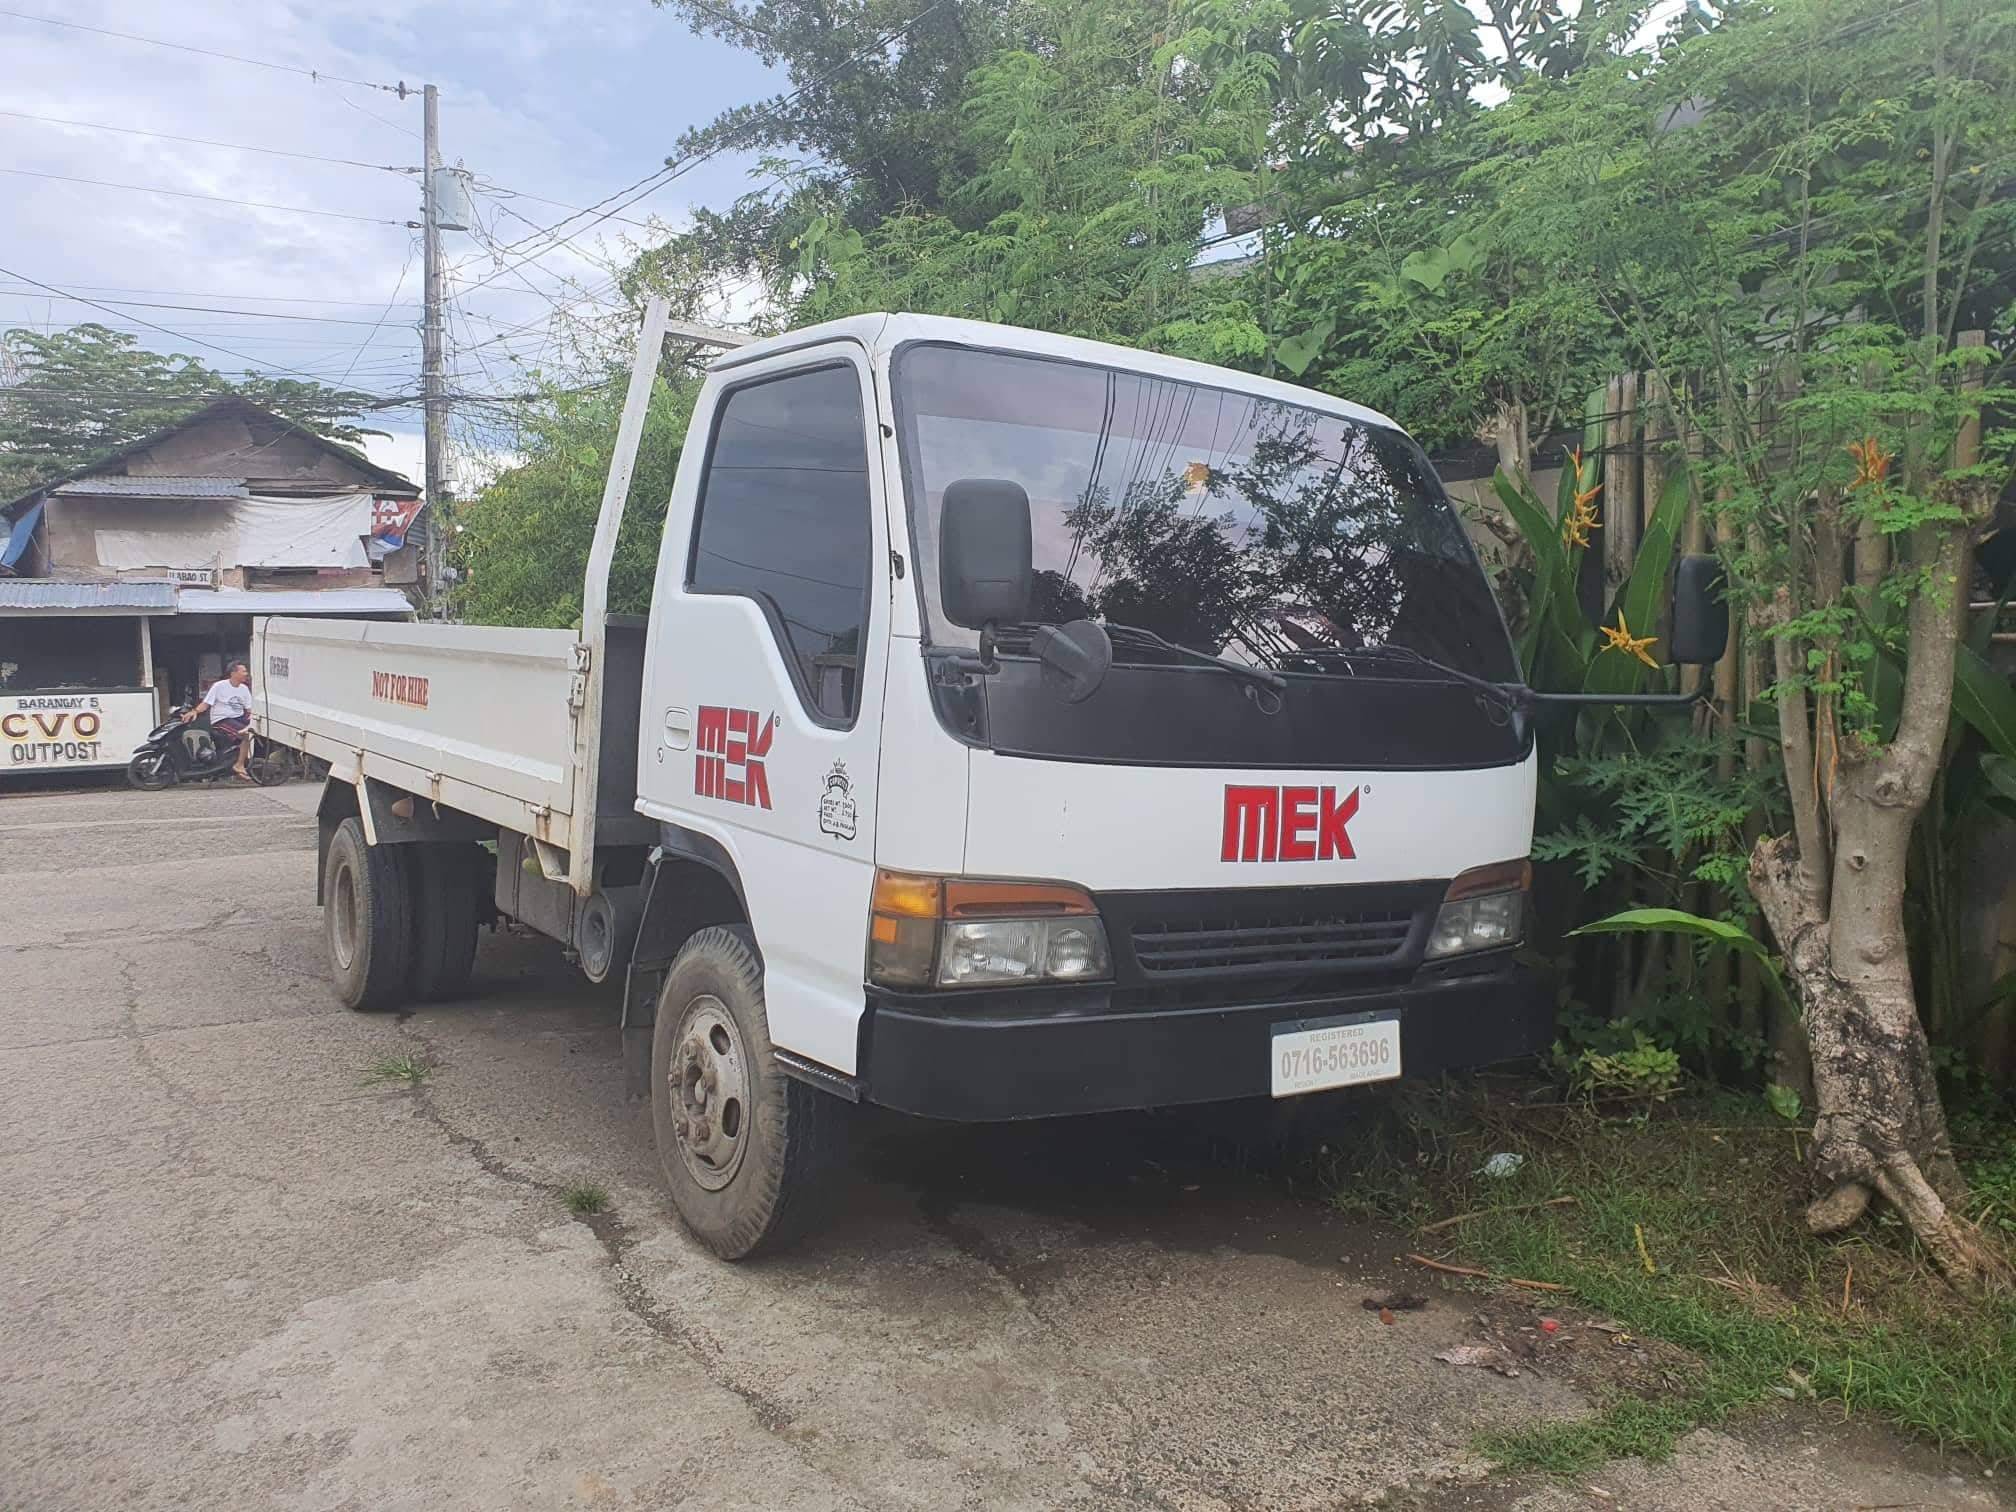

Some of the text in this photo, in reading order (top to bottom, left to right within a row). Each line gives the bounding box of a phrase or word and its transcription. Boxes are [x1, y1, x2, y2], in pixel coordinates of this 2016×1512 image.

[18, 697, 85, 709] BARANGAY
[372, 670, 429, 707] NOT FOR HIRE
[1, 711, 101, 738] CVO
[11, 741, 101, 763] OUTPOST
[695, 705, 775, 810] MEK
[1221, 784, 1360, 862] MEK
[1310, 1028, 1365, 1043] REGISTERED
[1281, 1038, 1390, 1079] 0716-563696
